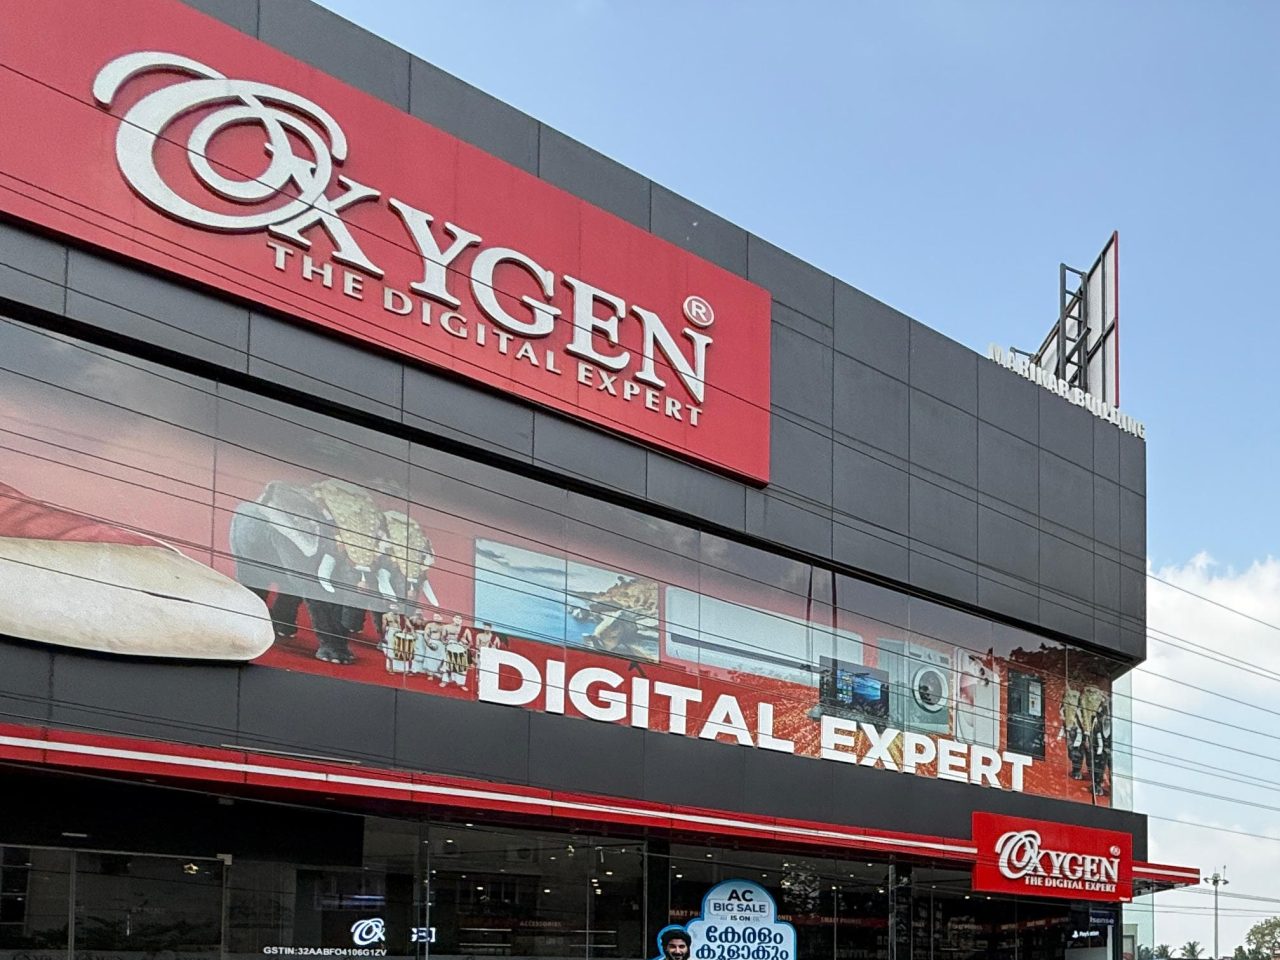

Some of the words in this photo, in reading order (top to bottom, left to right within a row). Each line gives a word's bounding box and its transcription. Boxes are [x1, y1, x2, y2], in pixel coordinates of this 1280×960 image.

[93, 51, 712, 403] OXYGEN
[266, 241, 364, 299] THE
[383, 287, 561, 375] DIGITAL
[576, 363, 704, 427] EXPERT
[1074, 387, 1145, 439] BUILDING
[477, 646, 794, 753] DIGITAL
[818, 714, 1033, 791] EXPERT
[995, 830, 1120, 882] OXYGEN
[713, 902, 734, 912] BIG
[736, 903, 766, 913] SALE
[727, 889, 754, 902] AC
[1024, 875, 1043, 886] THE
[1045, 877, 1084, 891] DIGITAL
[1085, 881, 1117, 893] EXPERT
[705, 925, 784, 945] കേരളം
